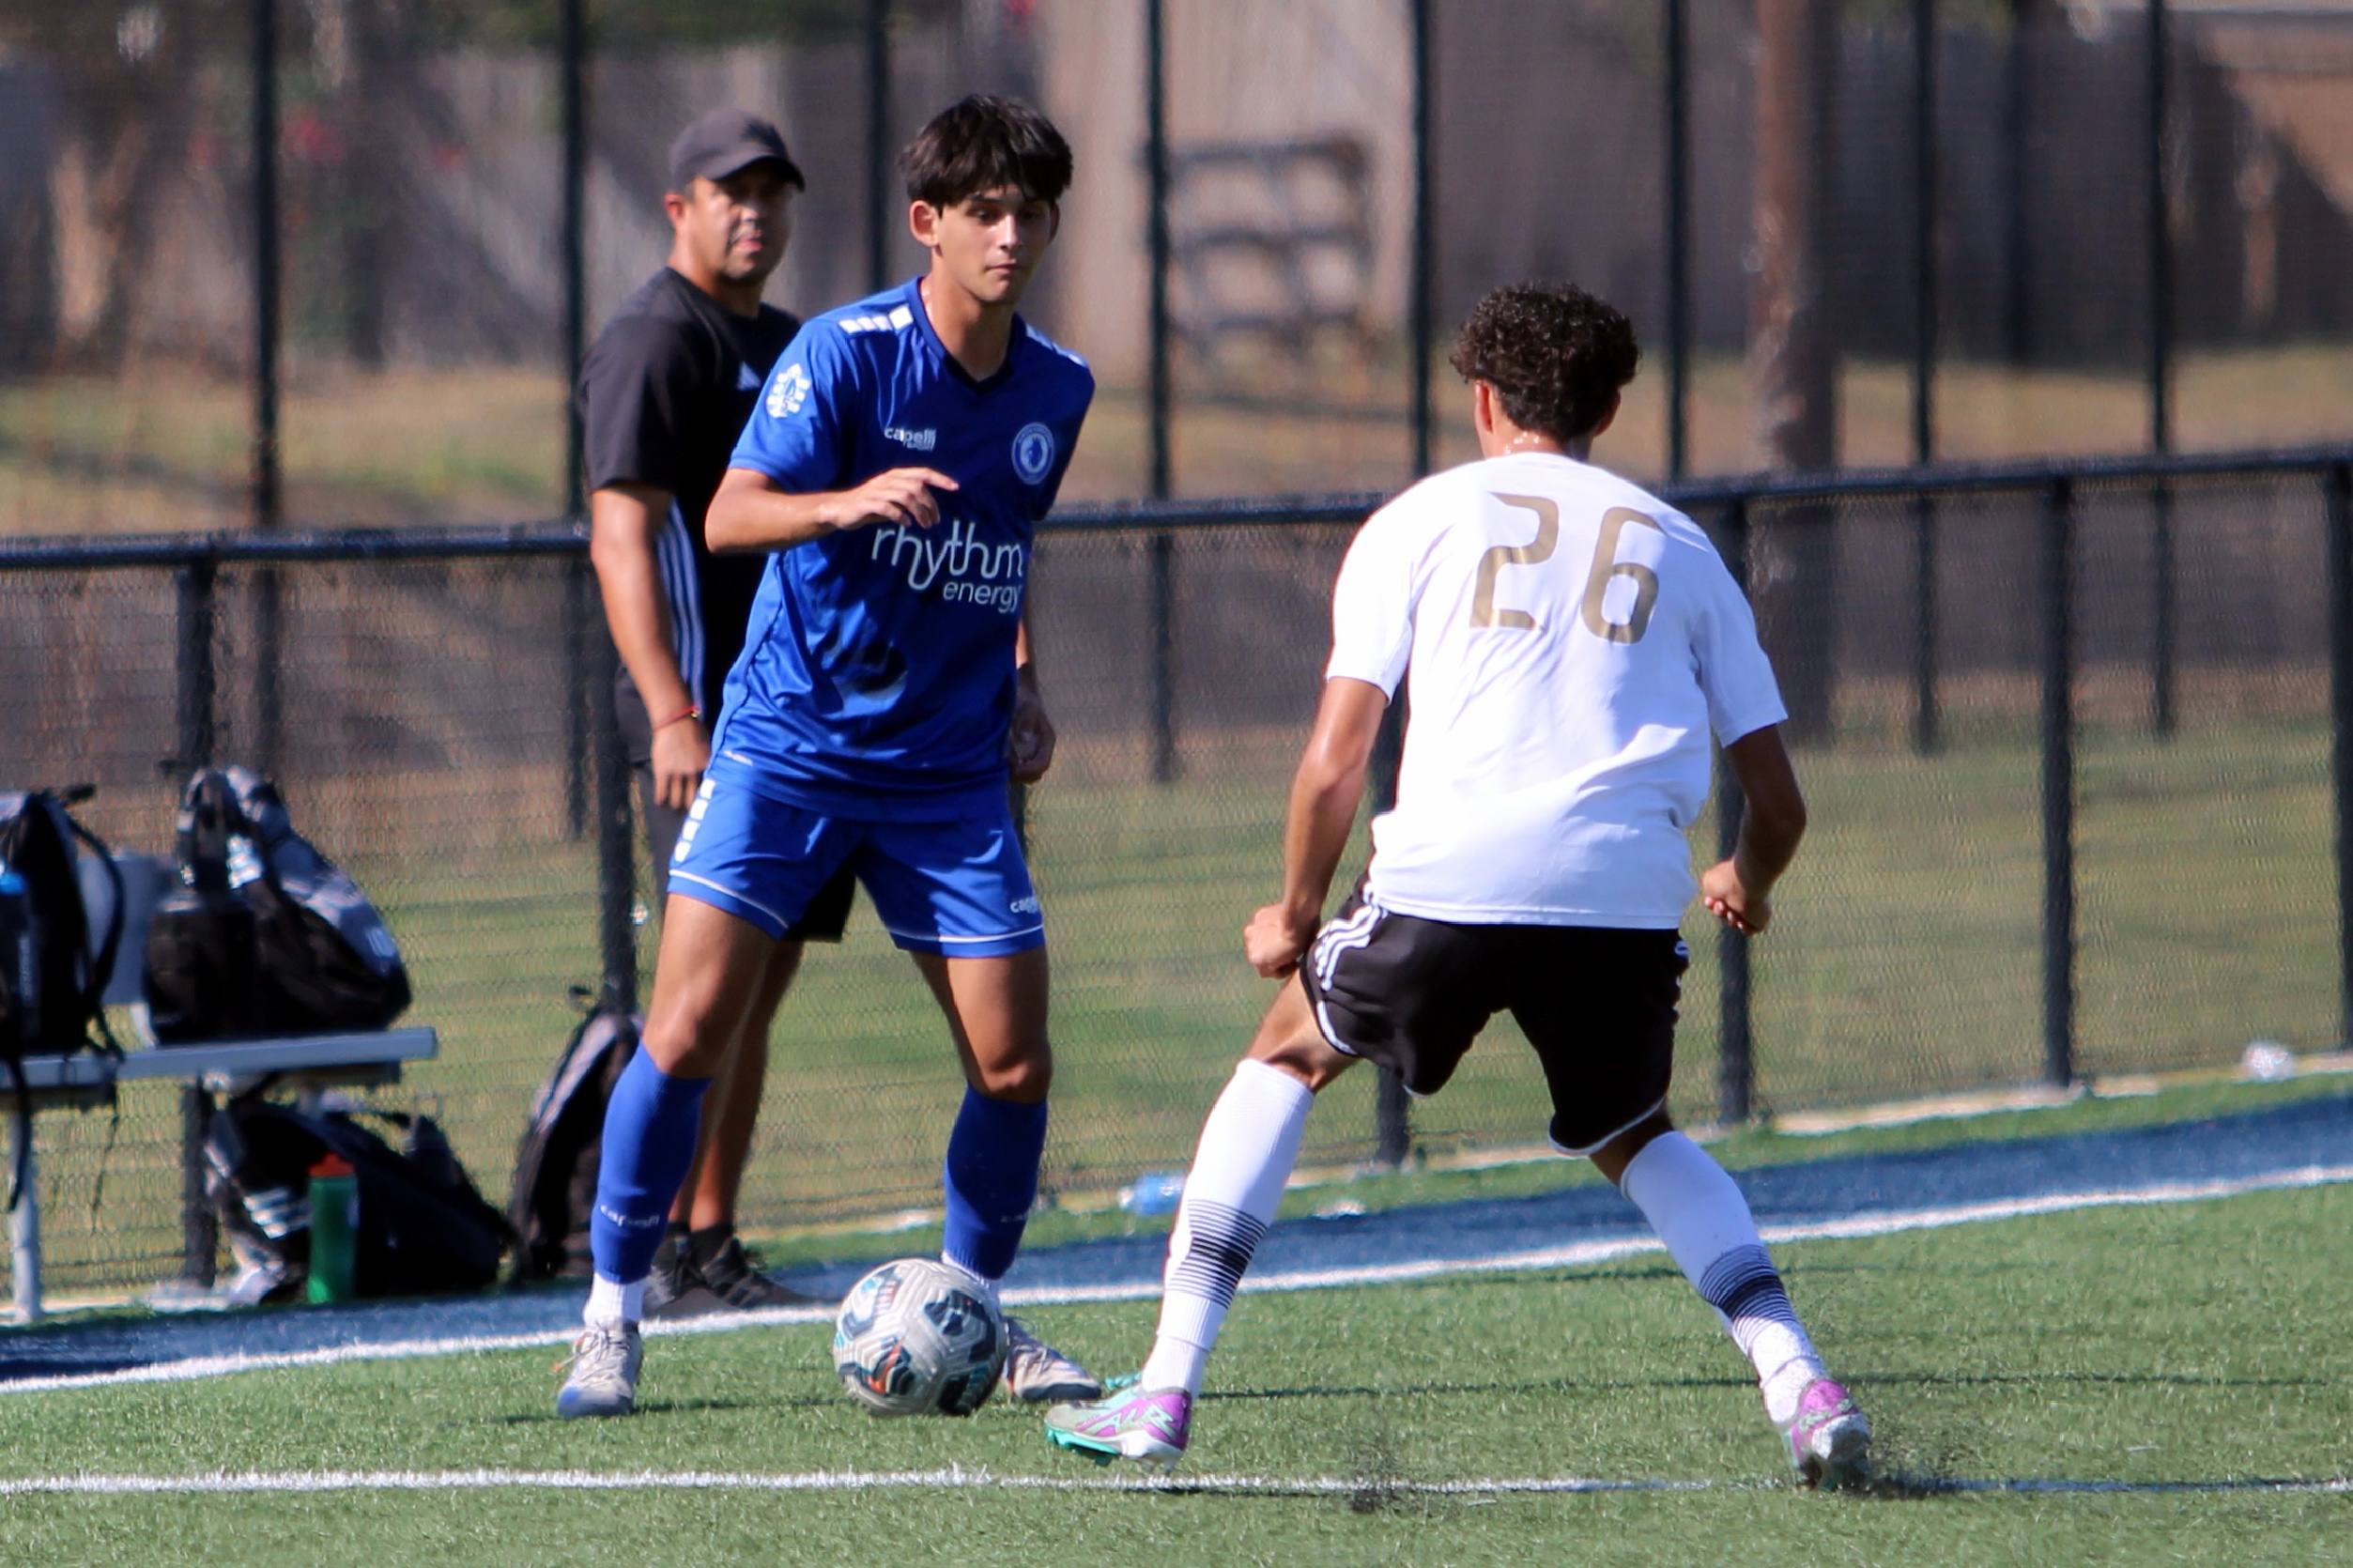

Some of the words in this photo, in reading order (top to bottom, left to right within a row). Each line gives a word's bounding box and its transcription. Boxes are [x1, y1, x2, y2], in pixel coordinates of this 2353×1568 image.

[884, 428, 937, 447] capelli
[871, 519, 1023, 592] rhythm
[1469, 490, 1669, 645] 26
[943, 581, 1023, 614] energy
